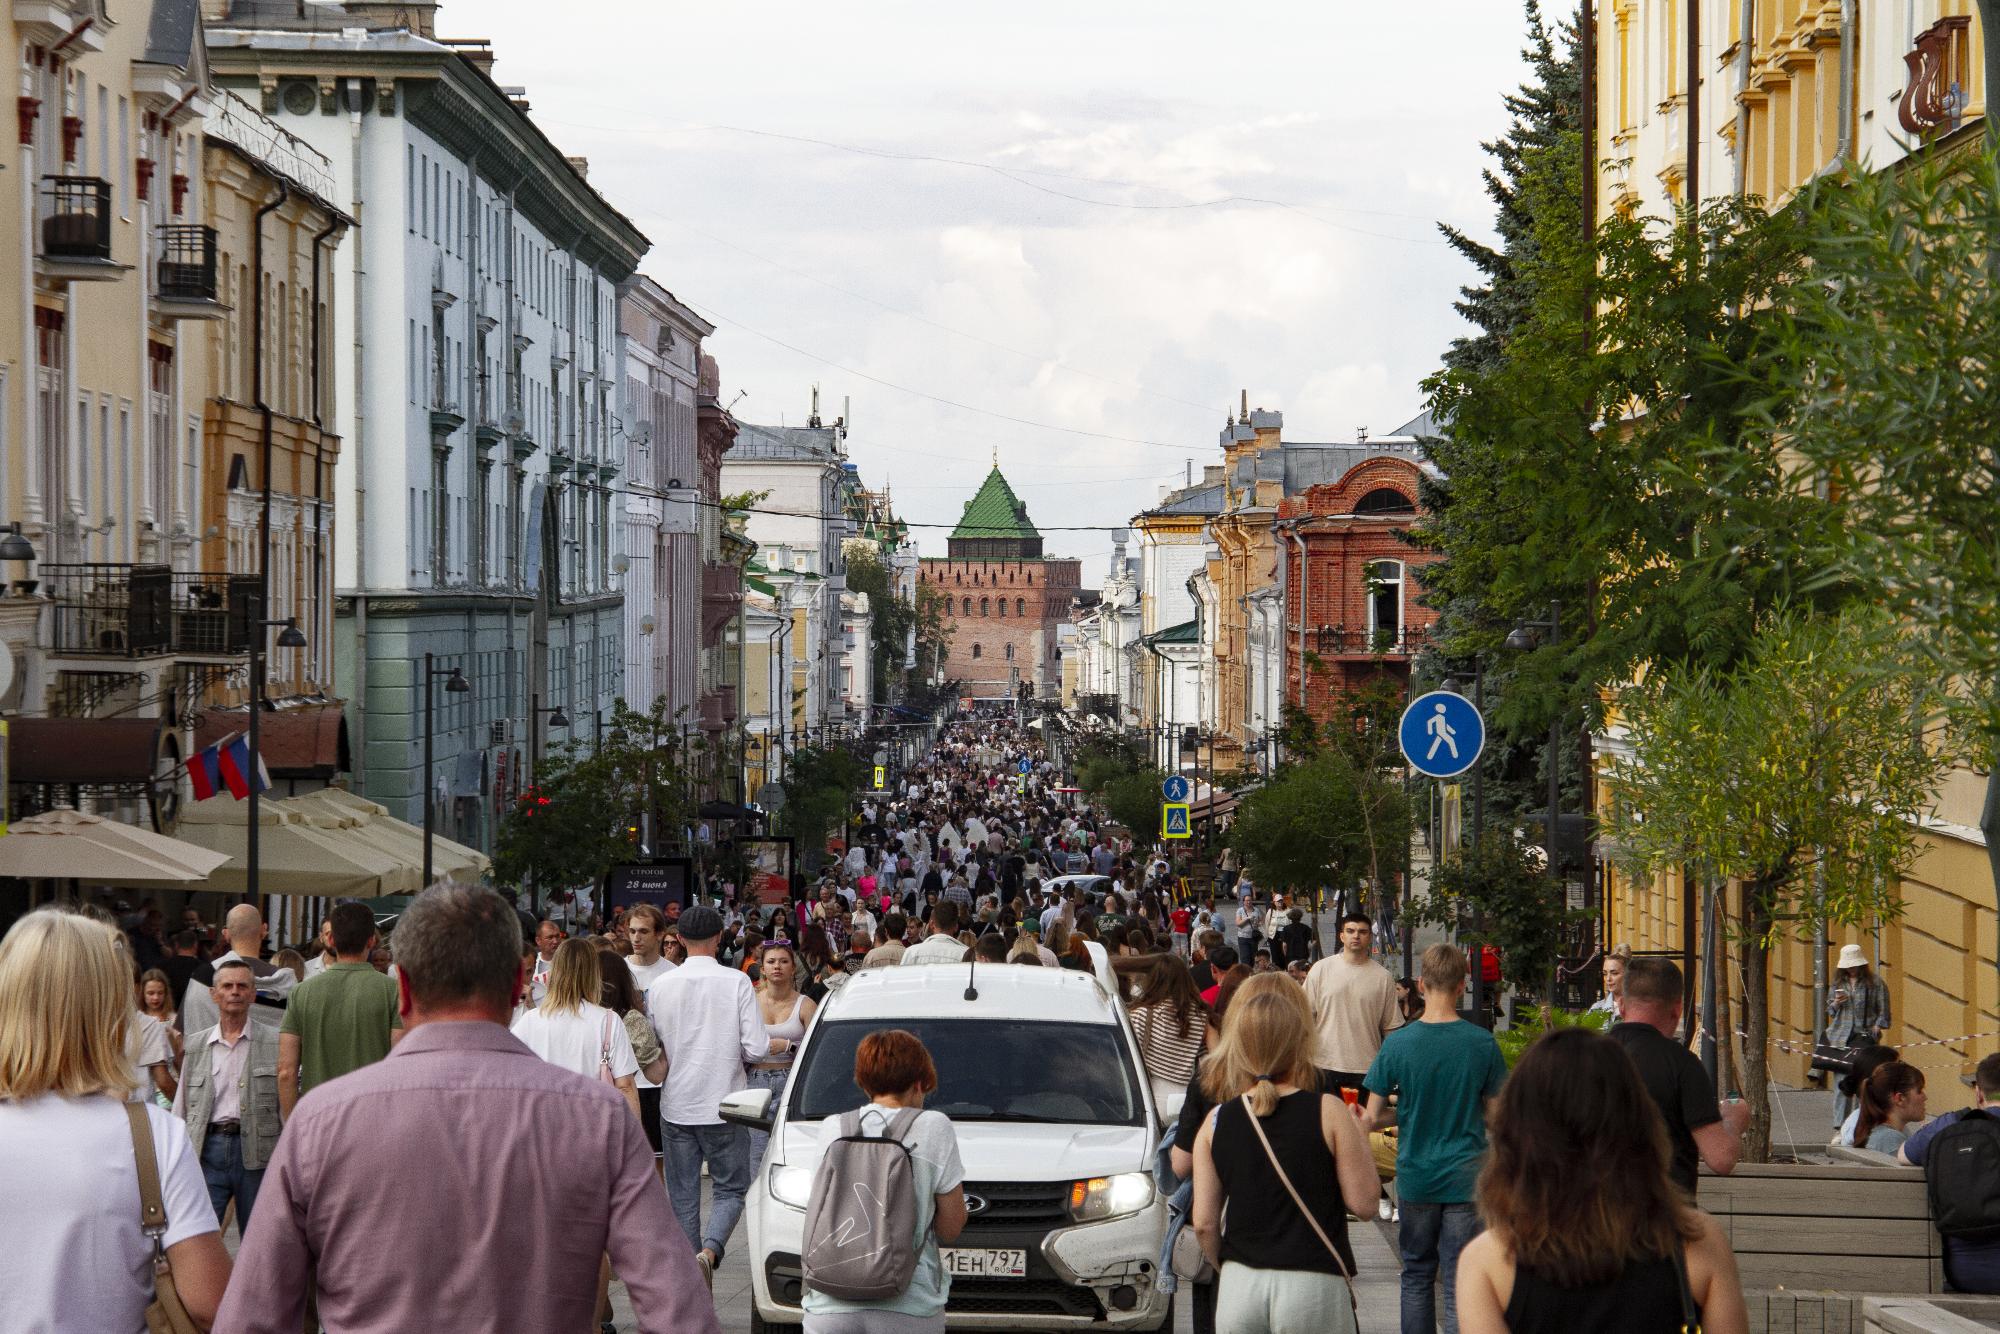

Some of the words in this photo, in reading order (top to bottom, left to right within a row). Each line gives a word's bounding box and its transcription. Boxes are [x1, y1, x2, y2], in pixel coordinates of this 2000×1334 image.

[626, 880, 640, 889] 28
[642, 881, 667, 889] июня
[988, 1250, 1021, 1267] 797
